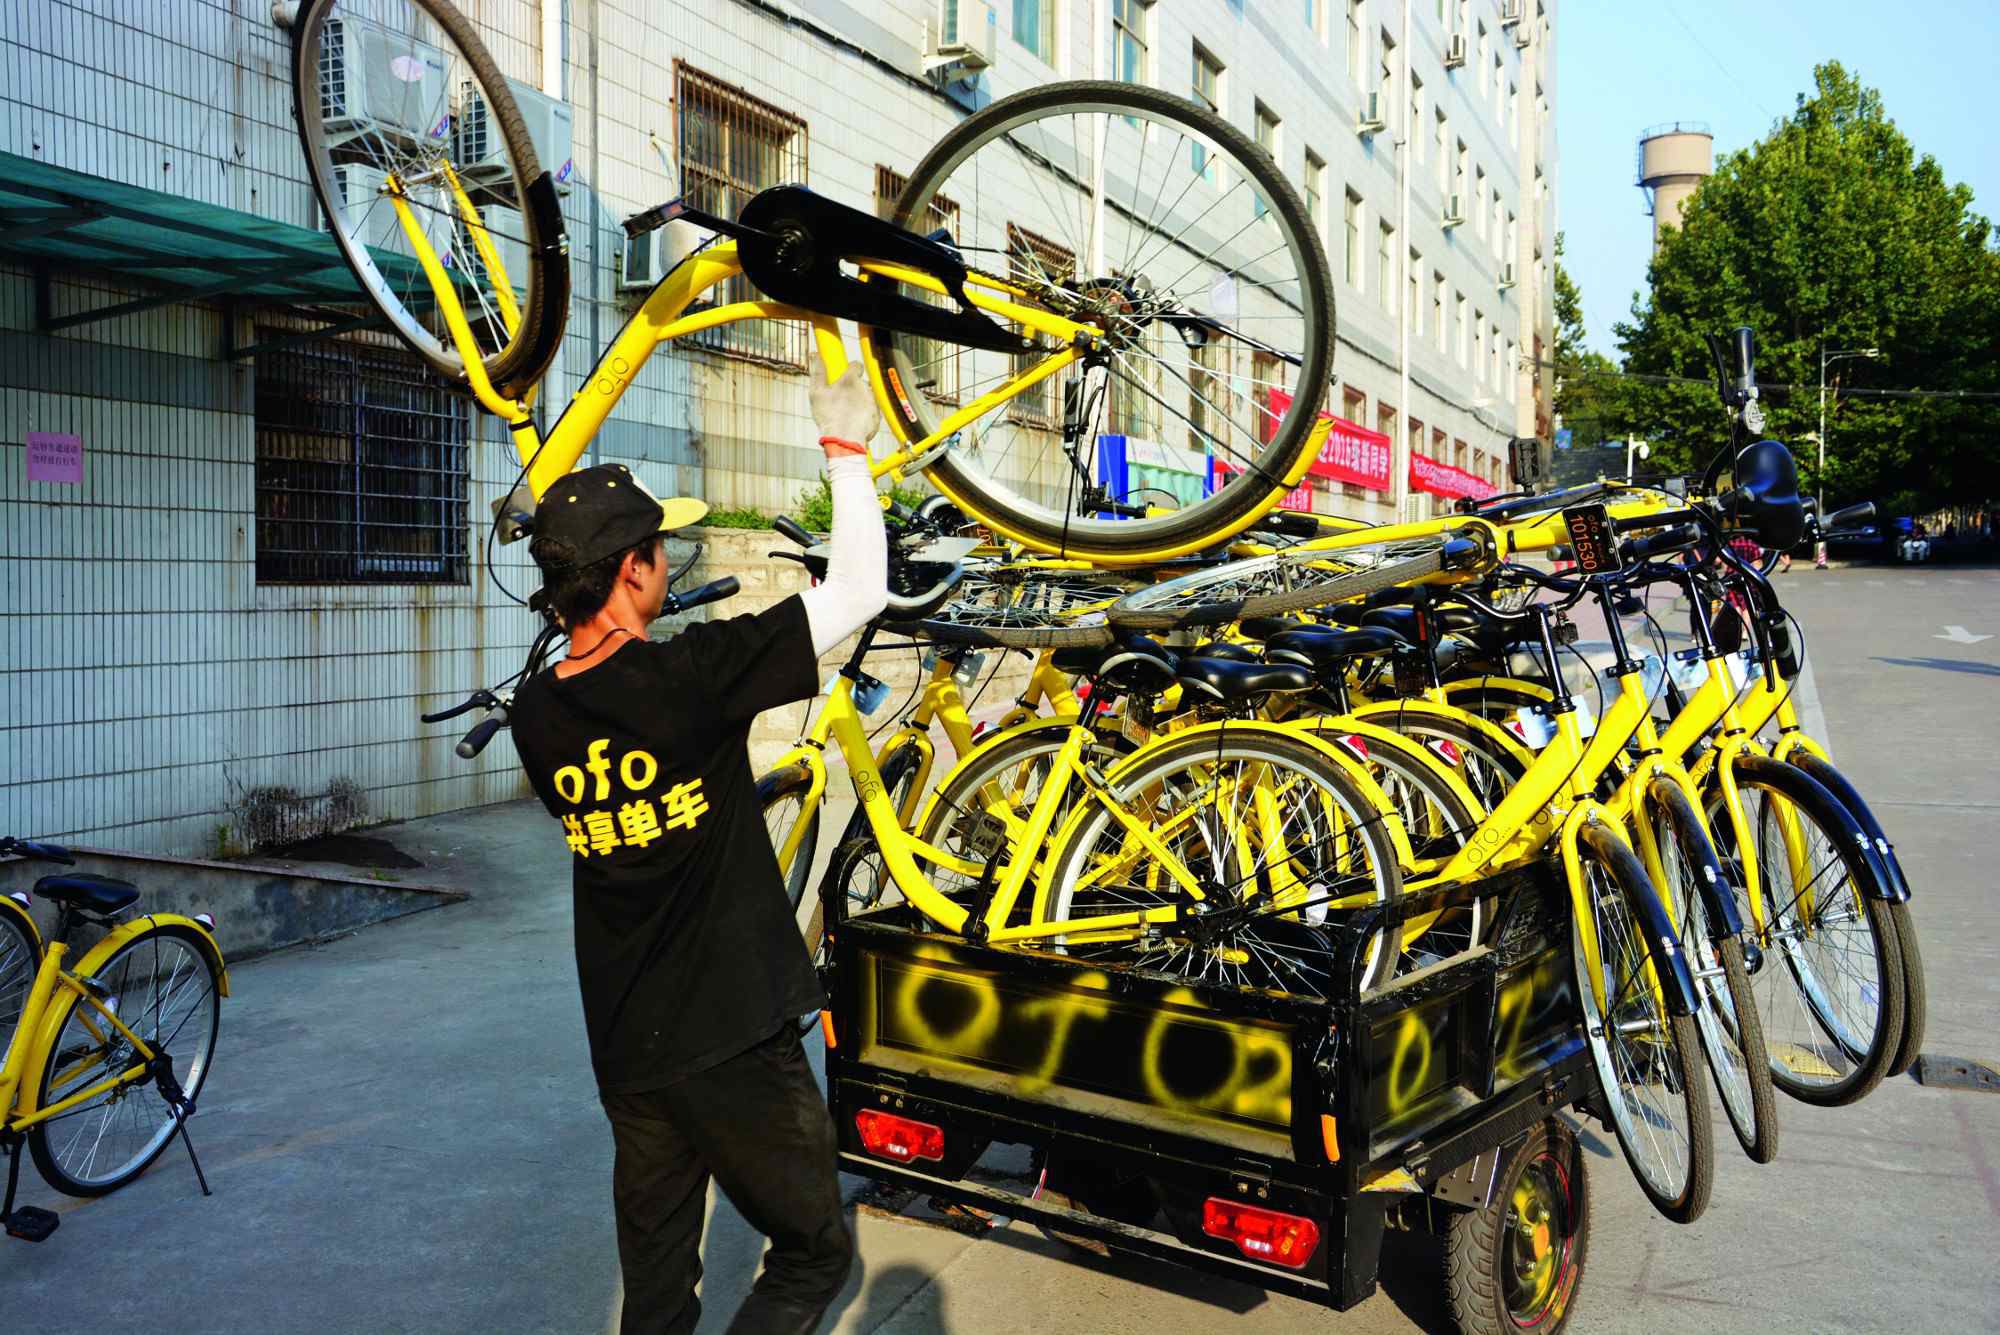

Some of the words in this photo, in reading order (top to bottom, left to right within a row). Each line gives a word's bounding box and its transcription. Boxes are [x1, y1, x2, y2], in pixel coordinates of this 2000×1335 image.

[597, 356, 630, 395] ofo
[1569, 514, 1597, 570] 101530
[553, 739, 658, 804] ofo
[857, 770, 879, 802] ofo
[561, 778, 709, 858] 共享单车
[1467, 828, 1499, 863] ofo
